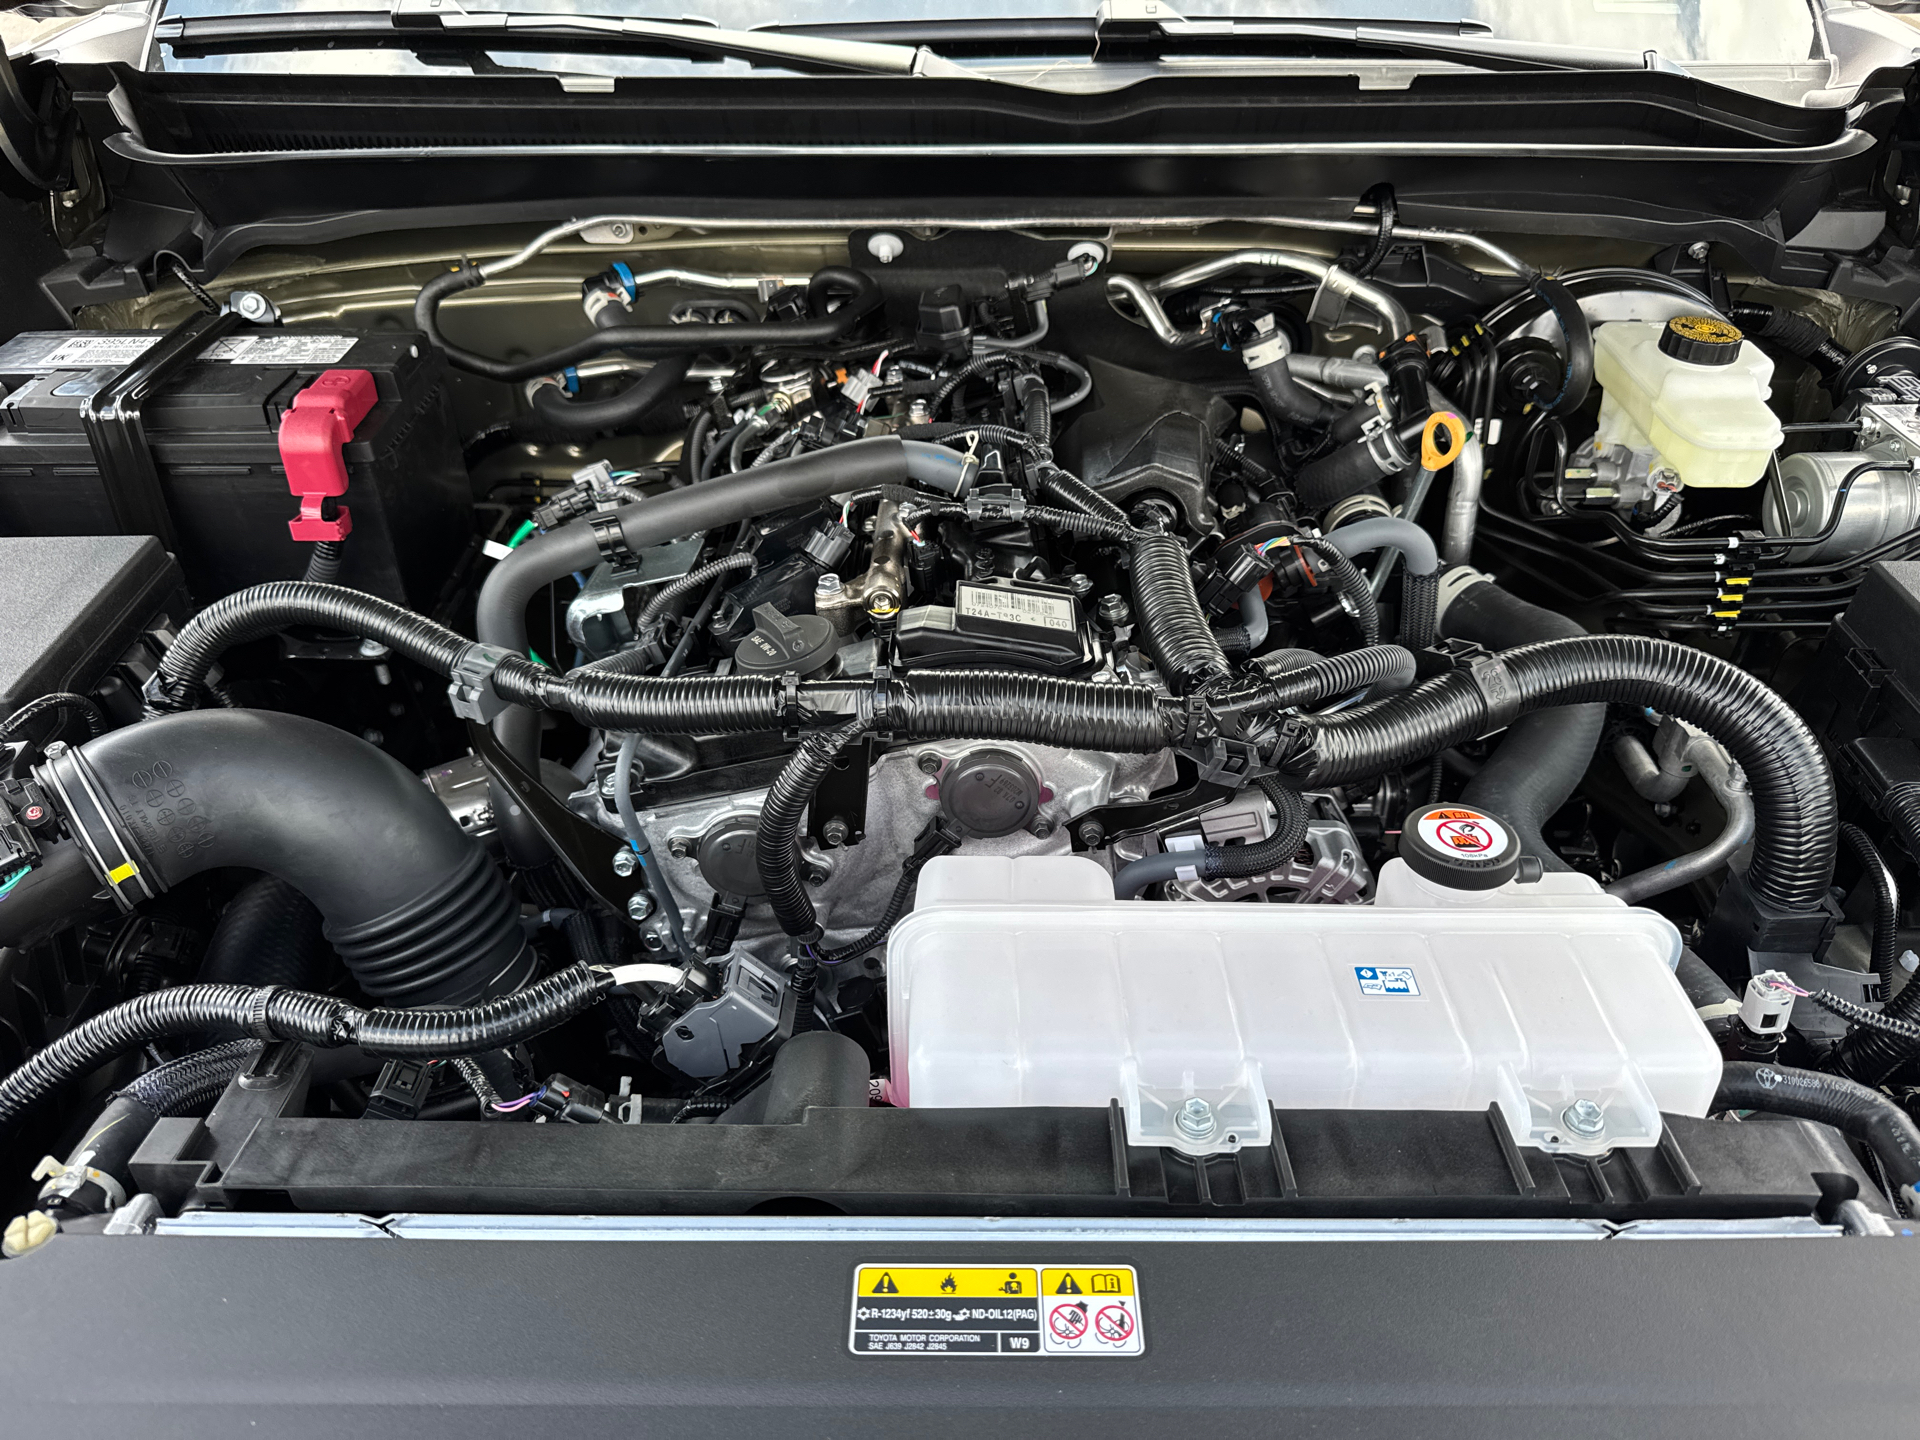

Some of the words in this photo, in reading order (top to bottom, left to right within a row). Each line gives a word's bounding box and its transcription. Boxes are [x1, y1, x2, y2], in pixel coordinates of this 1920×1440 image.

[750, 635, 765, 646] SAE
[871, 1308, 910, 1322] R-1234yf
[911, 1308, 952, 1322] 520±30g
[972, 1308, 1038, 1321] ND-OIL12(PAG)
[868, 1333, 898, 1342] TOYOTA
[900, 1333, 927, 1342] MOTOR
[928, 1334, 981, 1342] CORPORATION
[868, 1342, 884, 1350] SAE
[885, 1342, 902, 1350] J639
[904, 1342, 925, 1350] J2842
[927, 1342, 948, 1350] J2845
[1009, 1337, 1030, 1350] W9
